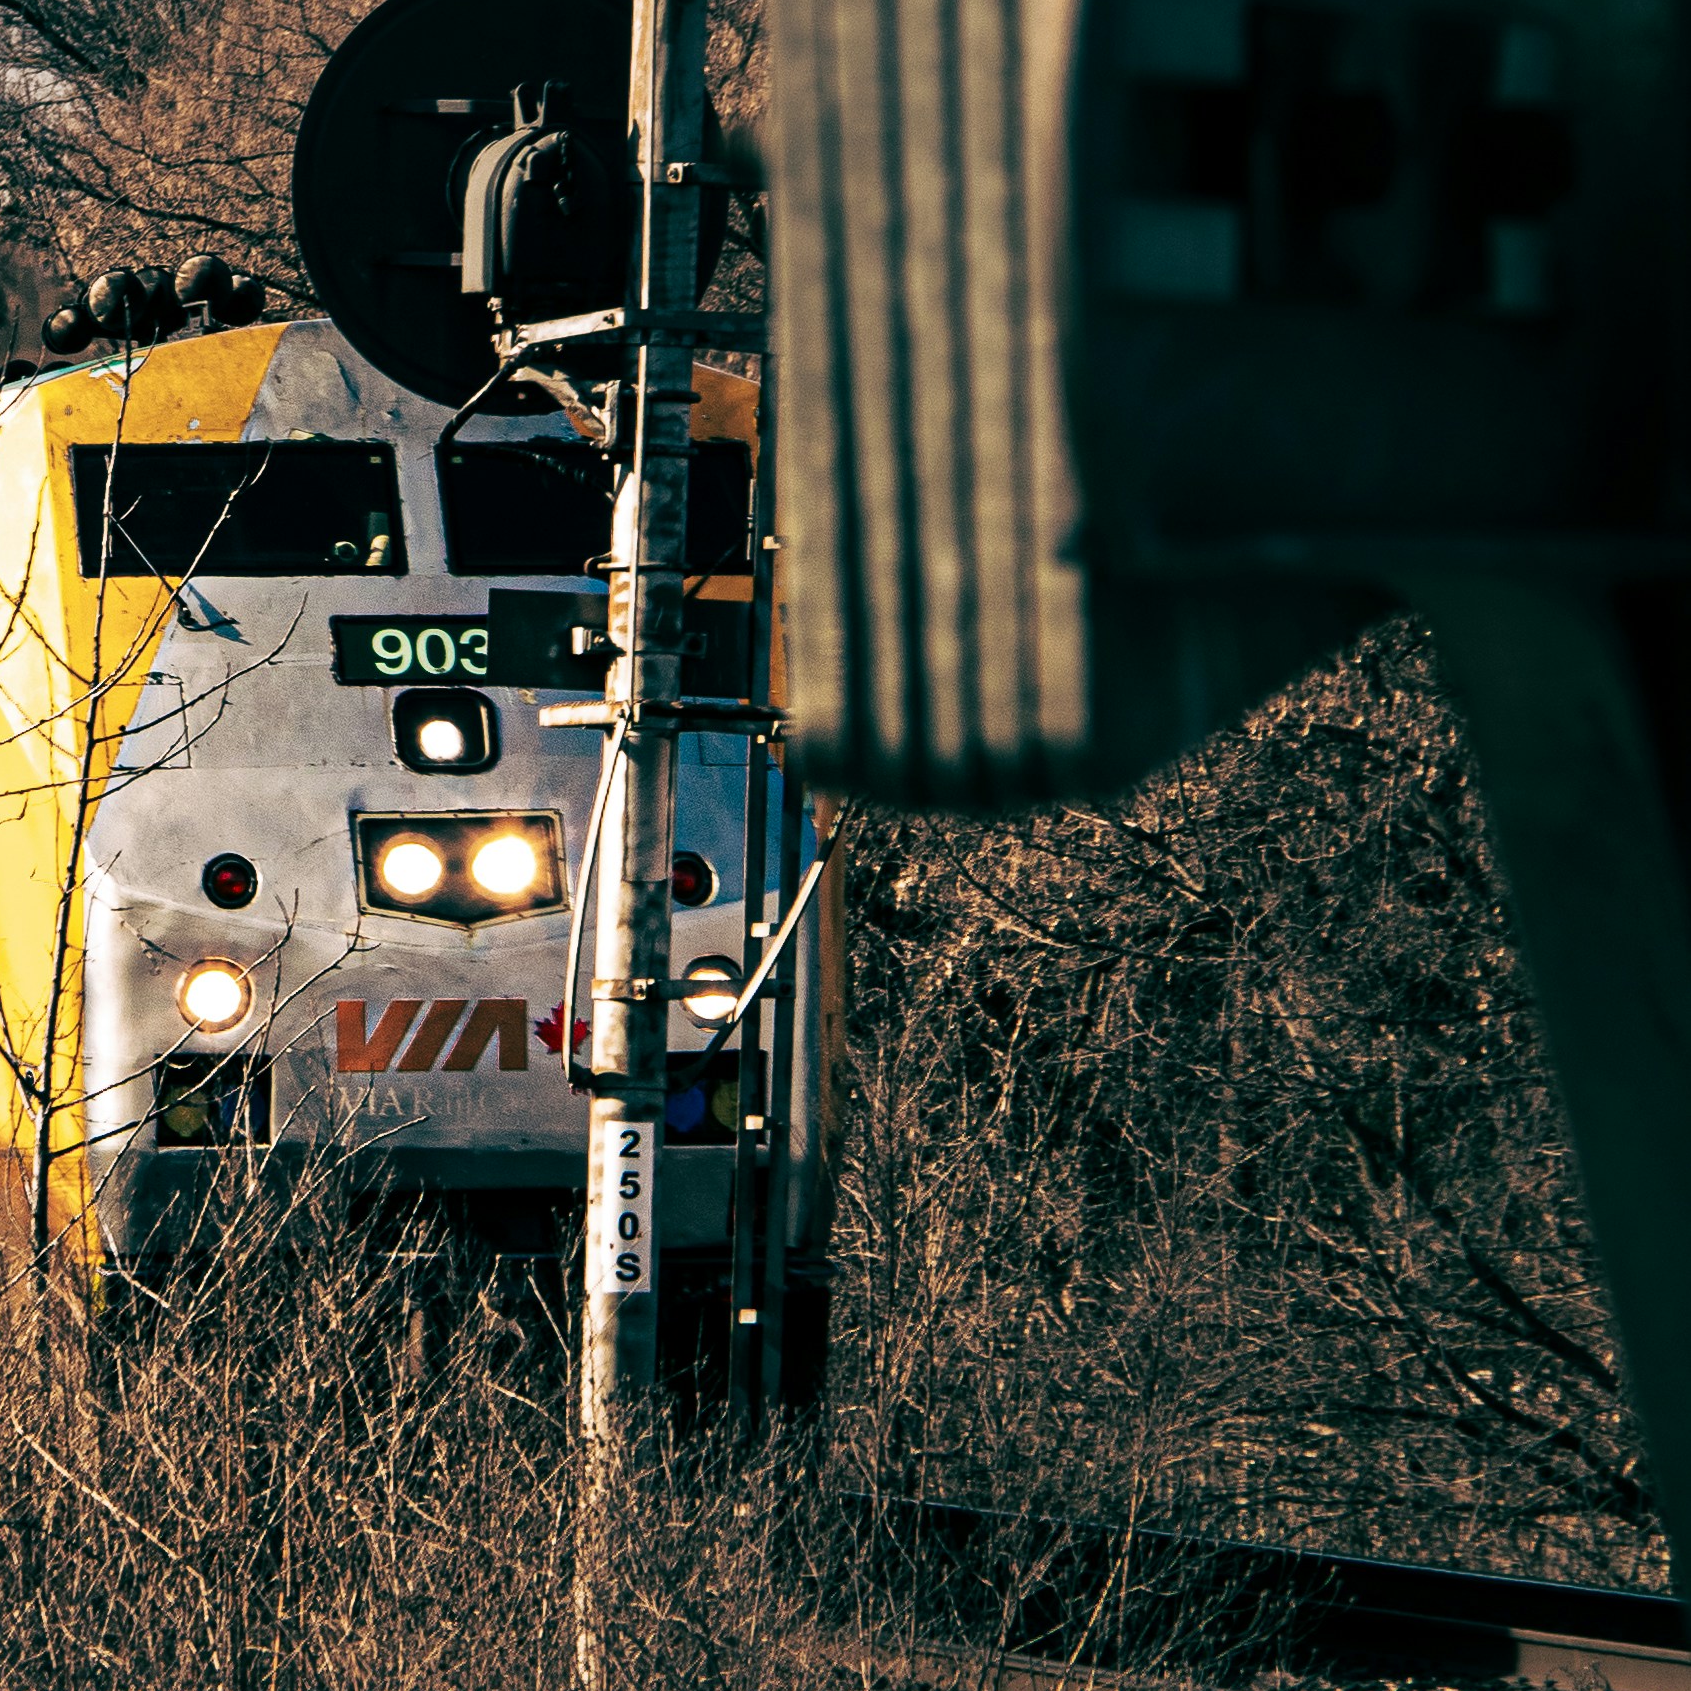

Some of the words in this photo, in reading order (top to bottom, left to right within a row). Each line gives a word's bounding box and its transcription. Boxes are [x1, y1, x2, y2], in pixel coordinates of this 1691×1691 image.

[371, 628, 488, 675] 903
[337, 998, 528, 1071] VIA
[615, 1129, 642, 1282] 250S
